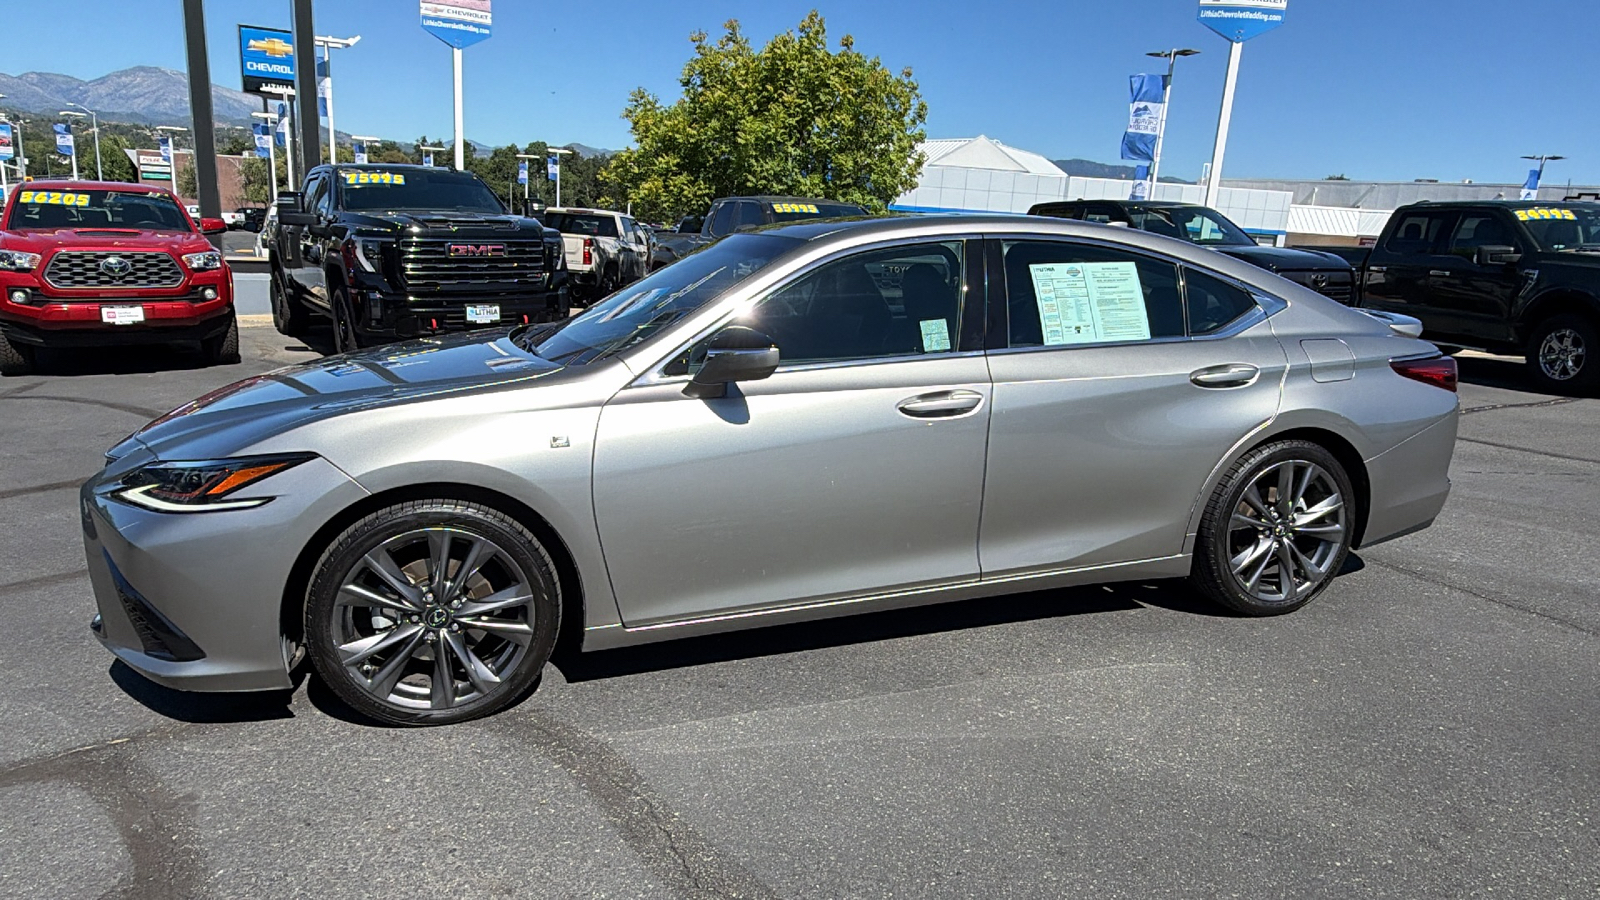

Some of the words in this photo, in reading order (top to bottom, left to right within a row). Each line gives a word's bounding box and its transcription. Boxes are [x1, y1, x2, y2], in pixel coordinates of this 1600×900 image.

[446, 8, 489, 20] CHEVROLET
[1200, 9, 1282, 21] LithiaChevroletRedding.com
[246, 61, 295, 75] CHEVROL
[347, 173, 404, 184] 75995
[20, 191, 89, 206] 36205
[772, 203, 817, 213] 55995
[1514, 209, 1576, 220] 34995
[450, 245, 503, 256] GMC
